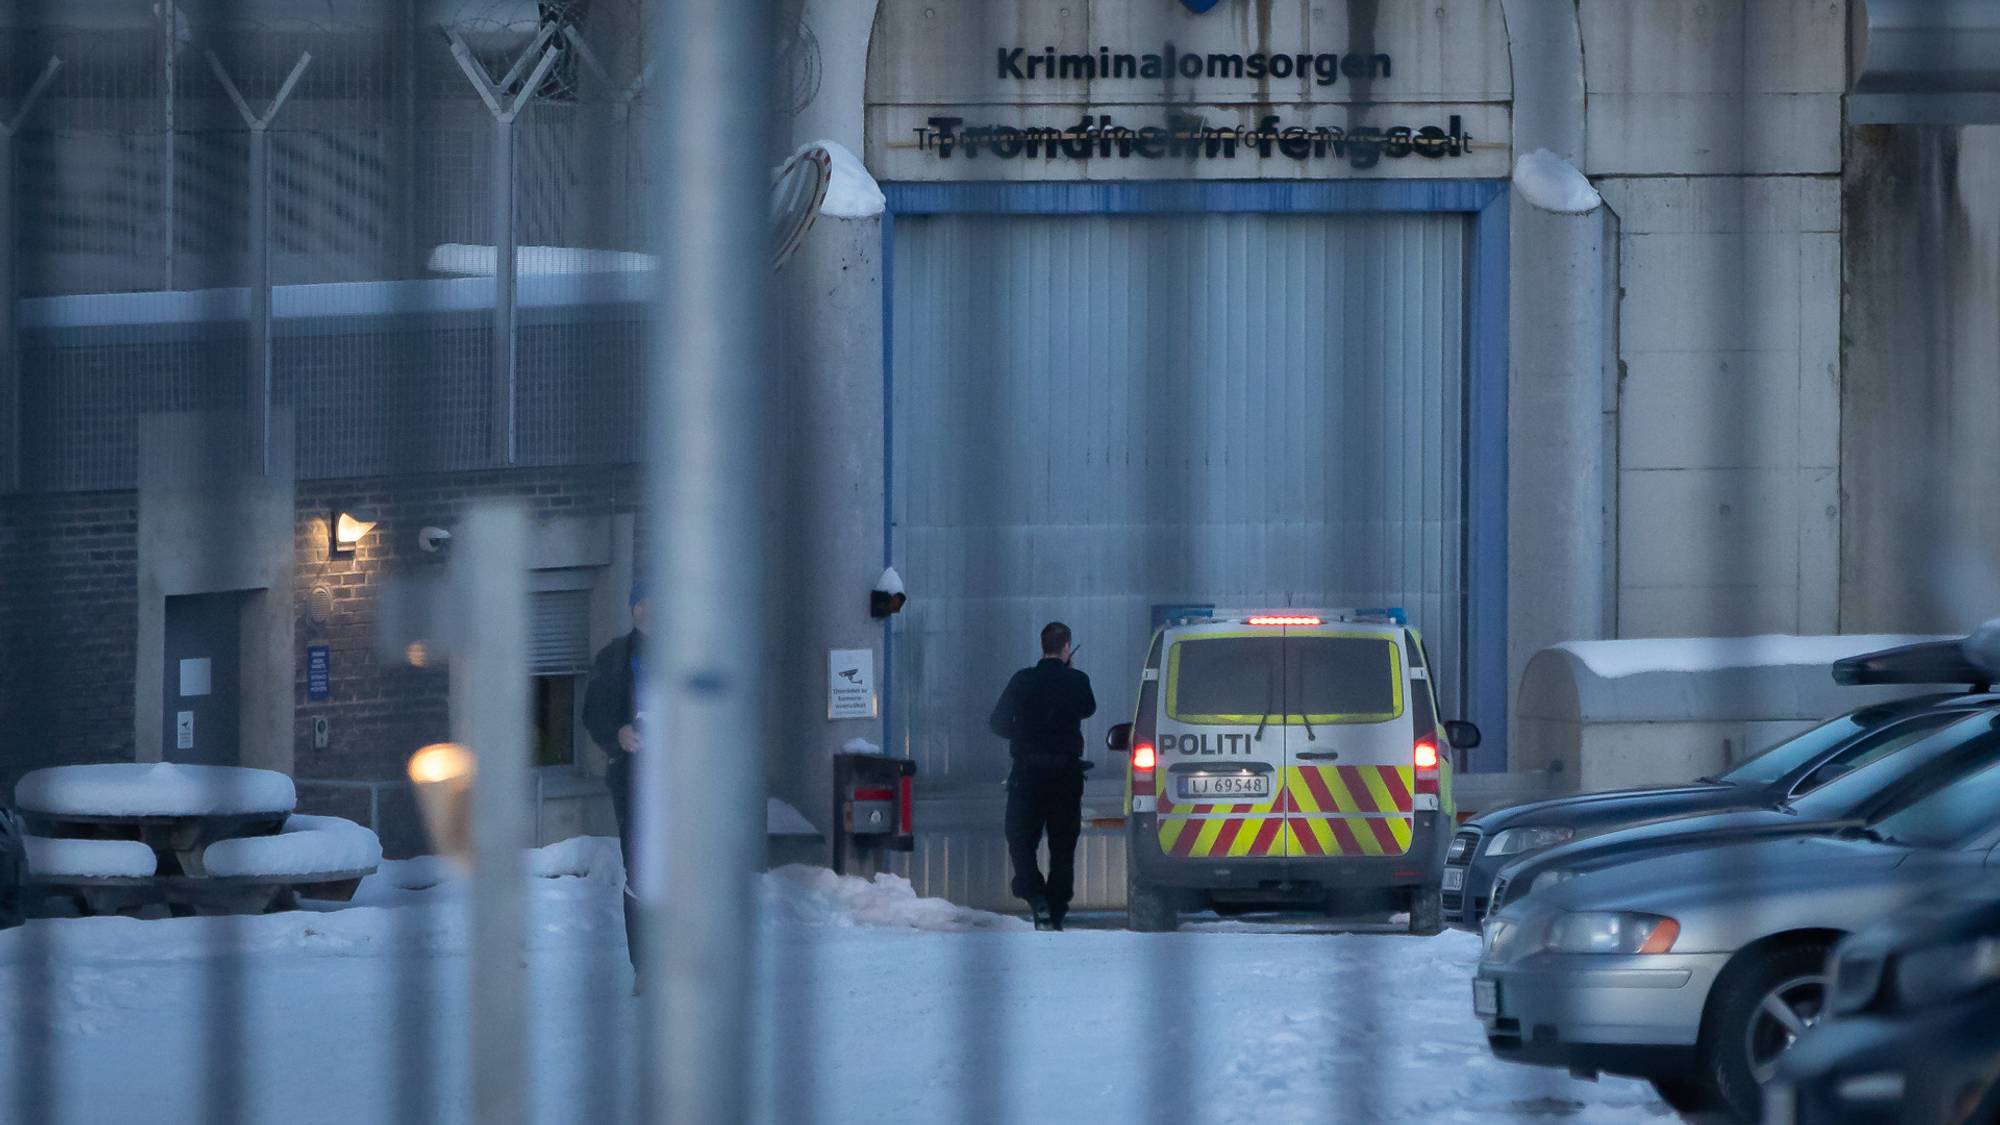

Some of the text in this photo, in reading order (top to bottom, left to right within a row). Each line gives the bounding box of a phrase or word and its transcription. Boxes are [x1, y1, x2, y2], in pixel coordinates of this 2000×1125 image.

[998, 46, 1391, 86] Kriminalomsorgen
[928, 115, 1236, 159] Trondheim
[1256, 114, 1461, 169] fengsel
[1158, 733, 1251, 756] POLITI
[1192, 778, 1262, 793] LJ 69548
